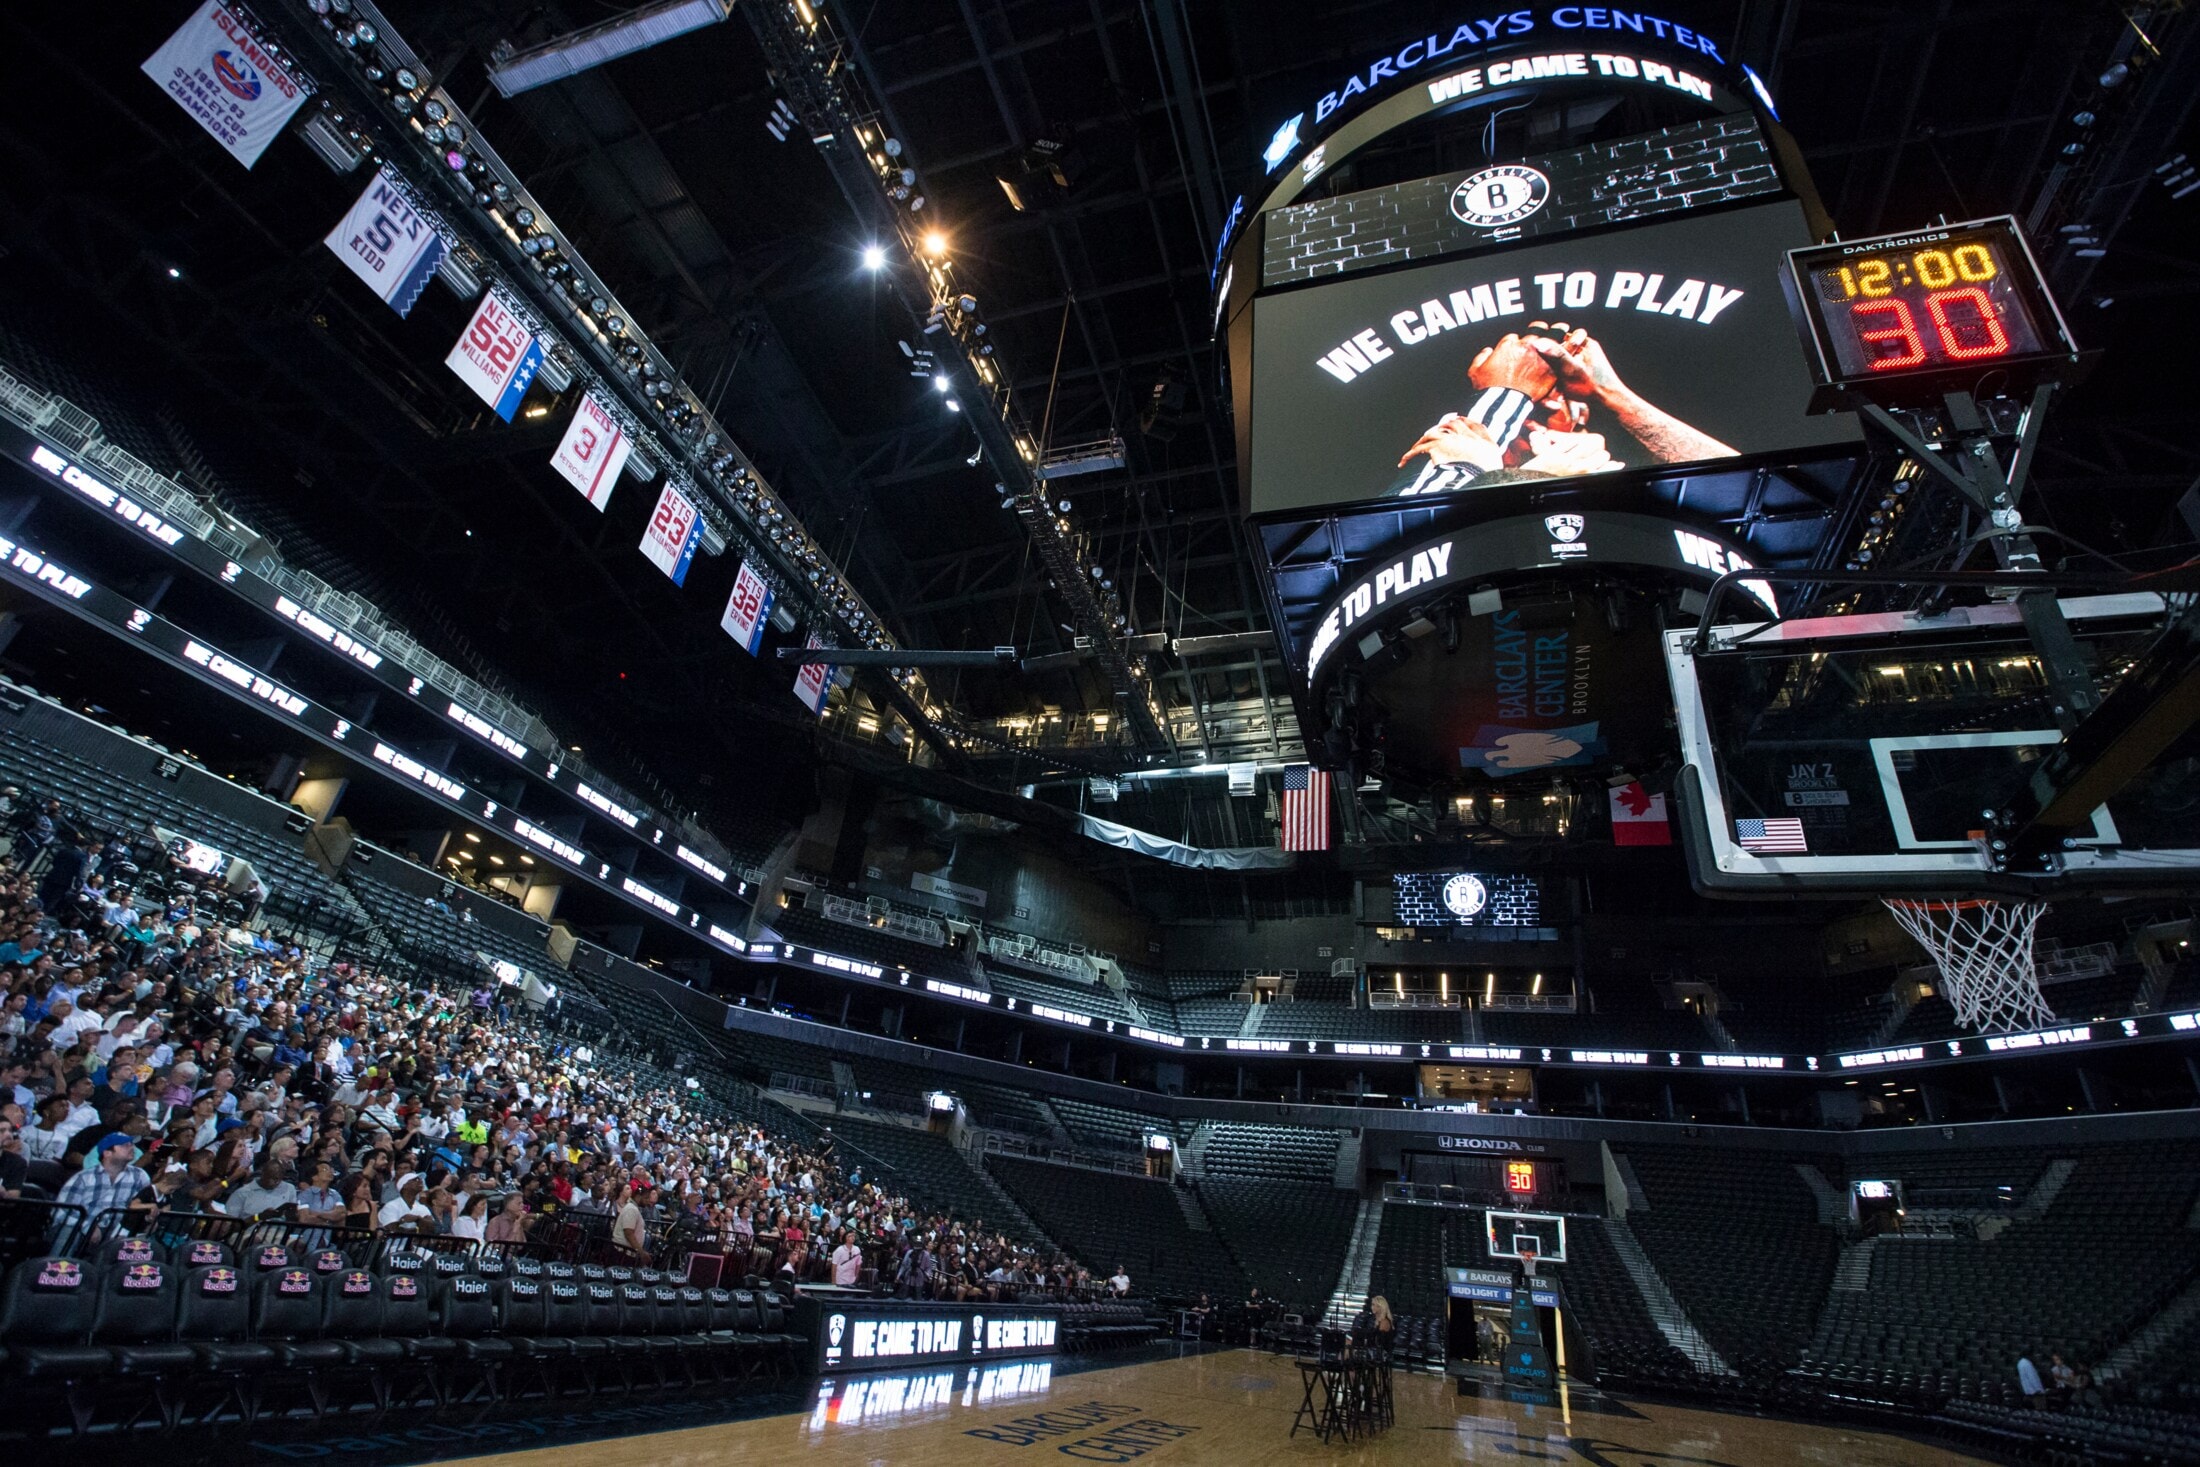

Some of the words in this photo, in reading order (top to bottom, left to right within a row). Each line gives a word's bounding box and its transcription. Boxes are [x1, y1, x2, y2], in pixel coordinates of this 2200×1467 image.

[211, 8, 299, 100] ISLANDERS
[1315, 10, 1534, 125] BARCLAYS
[1551, 8, 1726, 65] CENTER
[1428, 72, 1484, 103] WE
[1488, 53, 1588, 85] CAME
[1592, 53, 1636, 78] TO
[1641, 58, 1714, 101] PLAY
[168, 79, 238, 146] CHAMPIONS
[174, 67, 224, 116] STANLEY
[223, 113, 248, 138] CUP
[1457, 168, 1539, 196] BROOKLYN
[1487, 184, 1508, 209] B
[372, 184, 424, 242] NETS
[1462, 211, 1494, 225] NEW
[1501, 198, 1540, 221] YORK
[364, 211, 403, 255] 5
[1843, 232, 1950, 255] DAKTRONICS
[350, 235, 386, 273] KIDD
[1829, 244, 1997, 298] 12:00
[485, 300, 525, 347] NETS
[1316, 328, 1395, 385] WE
[1390, 277, 1525, 346] CAME
[1533, 271, 1597, 310] TO
[1604, 271, 1745, 325] PLAY
[1851, 287, 2010, 371] 30
[469, 312, 517, 373] 52
[460, 338, 503, 385] WILLIAMS
[584, 399, 613, 432] NETS
[573, 427, 598, 463] 3
[559, 453, 589, 485] PETROVIC
[32, 447, 68, 475] WE
[116, 497, 142, 521] TO
[137, 512, 184, 545] PLAY
[664, 489, 692, 523] NETS
[653, 503, 686, 546] 23
[1674, 529, 1728, 576] WE
[12, 547, 43, 574] TO
[37, 562, 93, 599] PLAY
[739, 569, 763, 600] NETS
[1342, 582, 1372, 627] TO
[1376, 542, 1453, 605] PLAY
[732, 582, 759, 622] 32
[730, 609, 749, 632] ERVING
[1492, 609, 1528, 719] BARCLAYS
[1535, 631, 1568, 717] CENTER
[1572, 645, 1591, 715] BROOKLYN
[1787, 764, 1816, 779] JAY
[1822, 763, 1835, 778] Z
[1788, 779, 1837, 789] BROOKLYN
[1792, 793, 1804, 805] 8
[1014, 909, 1027, 918] 213
[1454, 1138, 1523, 1151] HONDA
[1510, 1174, 1531, 1190] 30
[390, 1256, 422, 1269] Haier
[436, 1260, 465, 1272] Haier
[478, 1261, 503, 1273] Haier
[518, 1264, 541, 1275] Haier
[550, 1266, 573, 1277] Haier
[583, 1268, 605, 1278] Haier
[611, 1269, 632, 1280] Haier
[455, 1280, 487, 1294] Haier
[512, 1281, 539, 1295] Haier
[552, 1284, 579, 1297] Haier
[590, 1286, 613, 1298] Haier
[625, 1288, 647, 1300] Haier
[656, 1289, 676, 1300] Haier
[1451, 1286, 1471, 1295] BUD
[1472, 1288, 1499, 1298] LIGHT
[1470, 1273, 1512, 1285] BARCLAYS
[683, 1290, 702, 1301] Haier
[853, 1321, 878, 1357] WE
[877, 1321, 916, 1356] CAME
[917, 1321, 933, 1354] TO
[933, 1320, 962, 1352] PLAY
[987, 1320, 1002, 1349] WE
[1002, 1320, 1026, 1348] CAME
[1027, 1320, 1038, 1346] TO
[1038, 1320, 1057, 1346] PLAY
[1509, 1366, 1547, 1377] BARCLAYS
[961, 1401, 1142, 1447] BARCLAYS
[1057, 1419, 1202, 1463] CENTER
